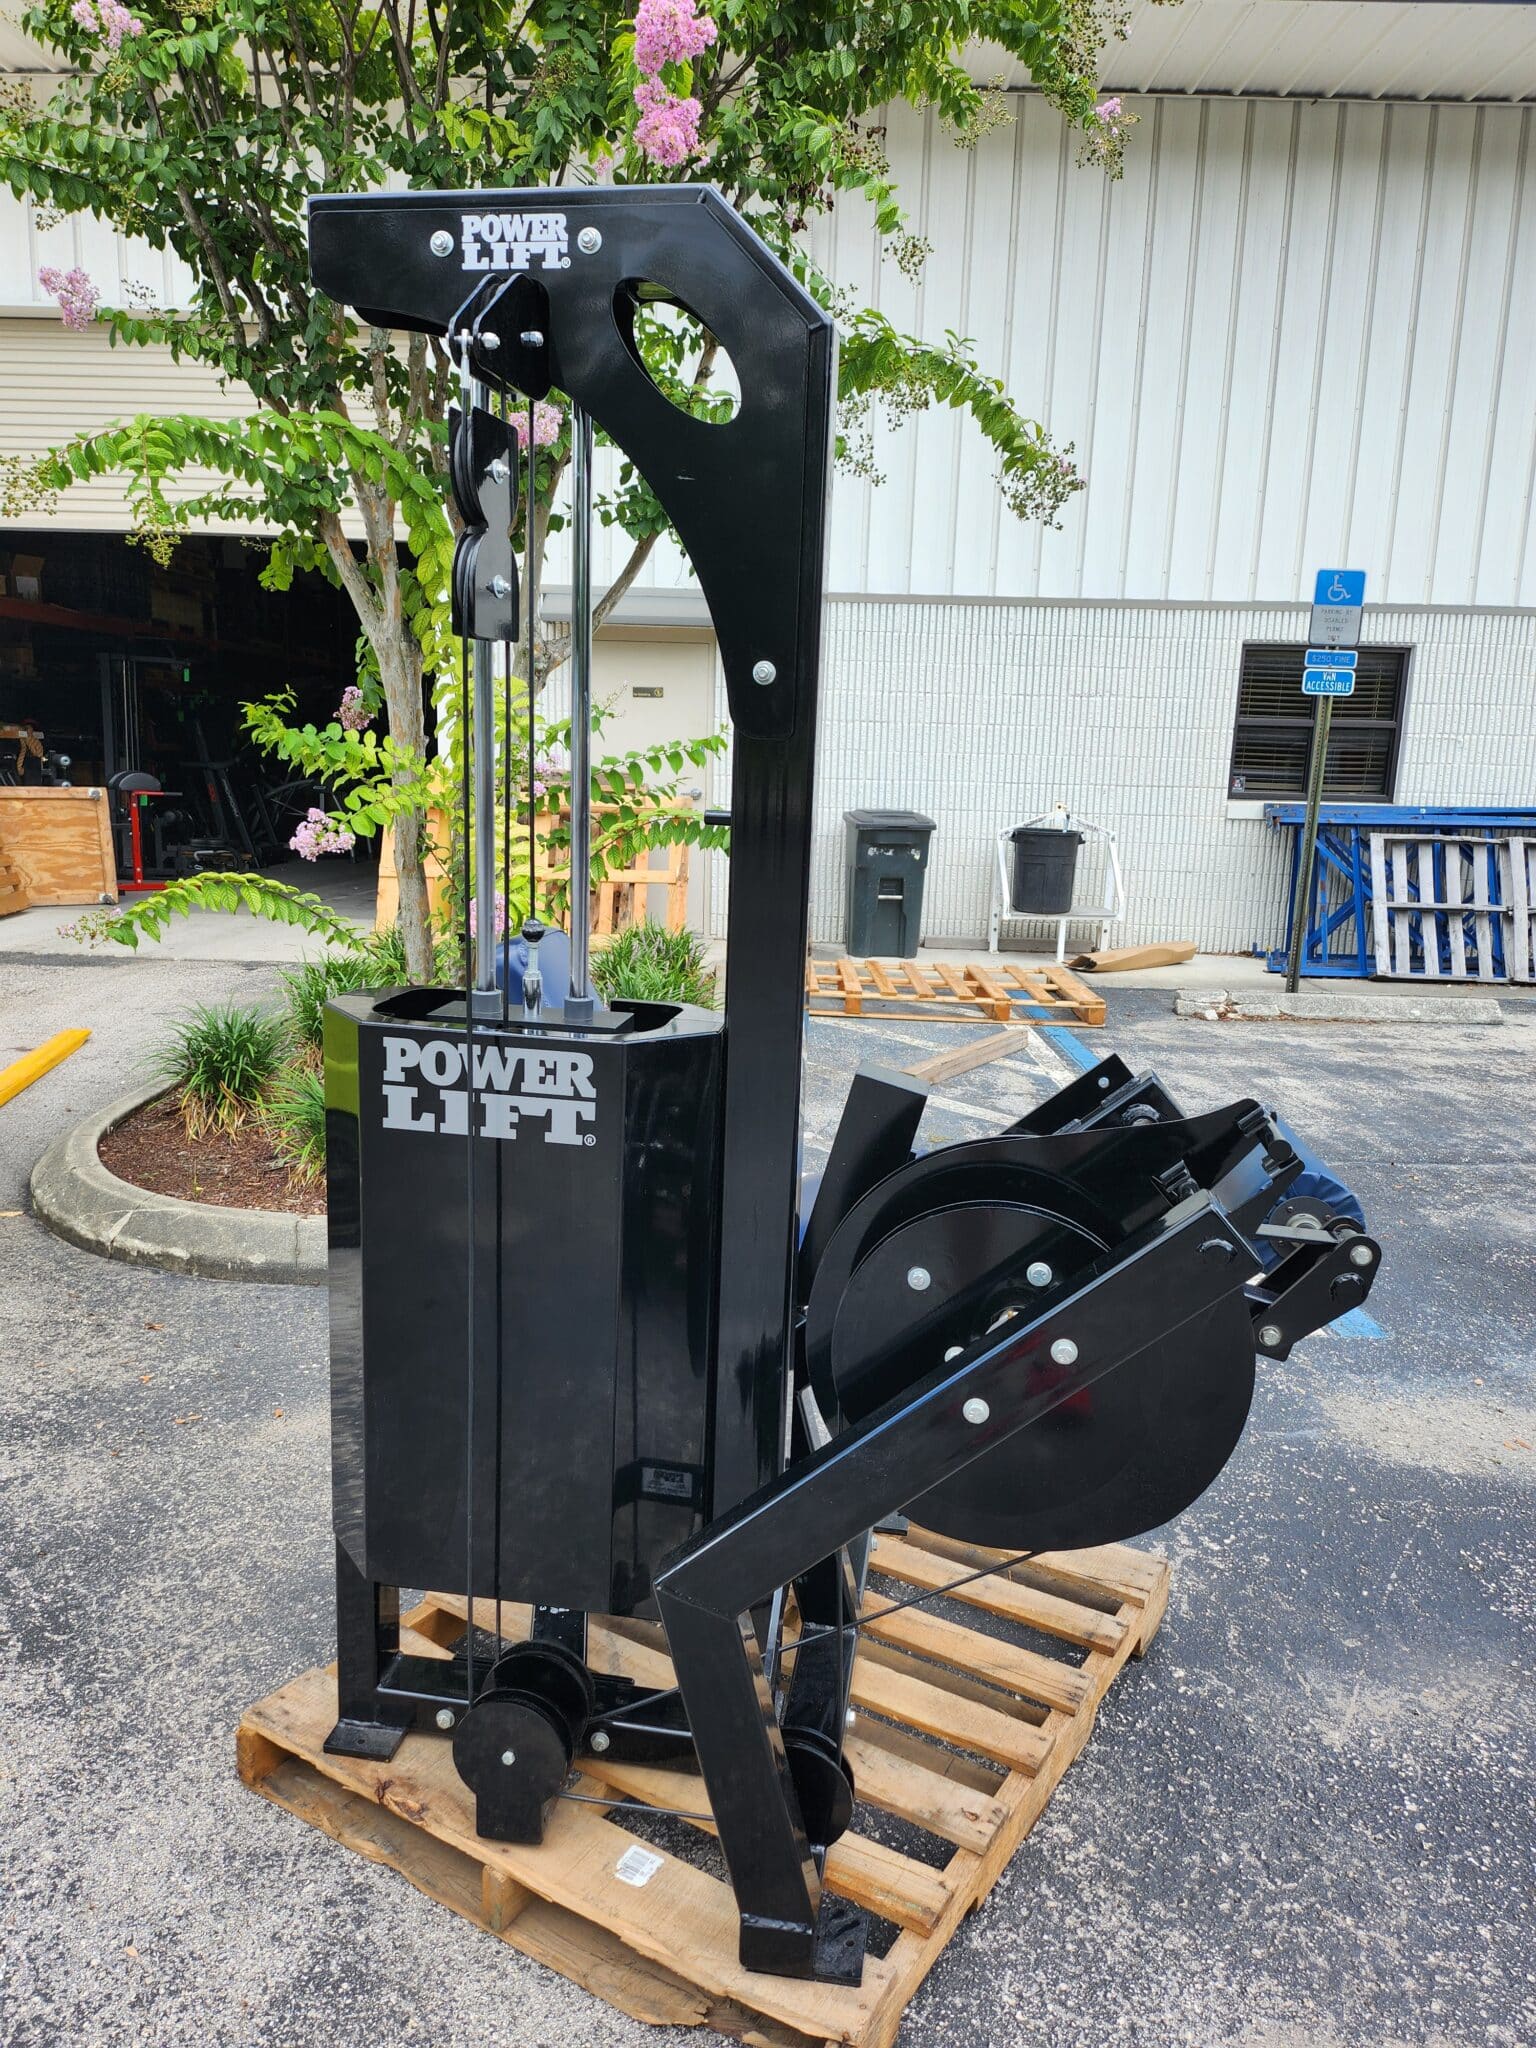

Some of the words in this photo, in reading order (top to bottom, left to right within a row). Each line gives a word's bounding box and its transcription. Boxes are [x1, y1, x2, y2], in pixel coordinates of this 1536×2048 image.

[461, 213, 568, 243] POWER
[1312, 654, 1331, 663] $250
[1335, 655, 1351, 664] FINE
[1322, 671, 1337, 681] VAN
[1306, 680, 1351, 692] ACCESSIBLE
[382, 1036, 597, 1099] POWER
